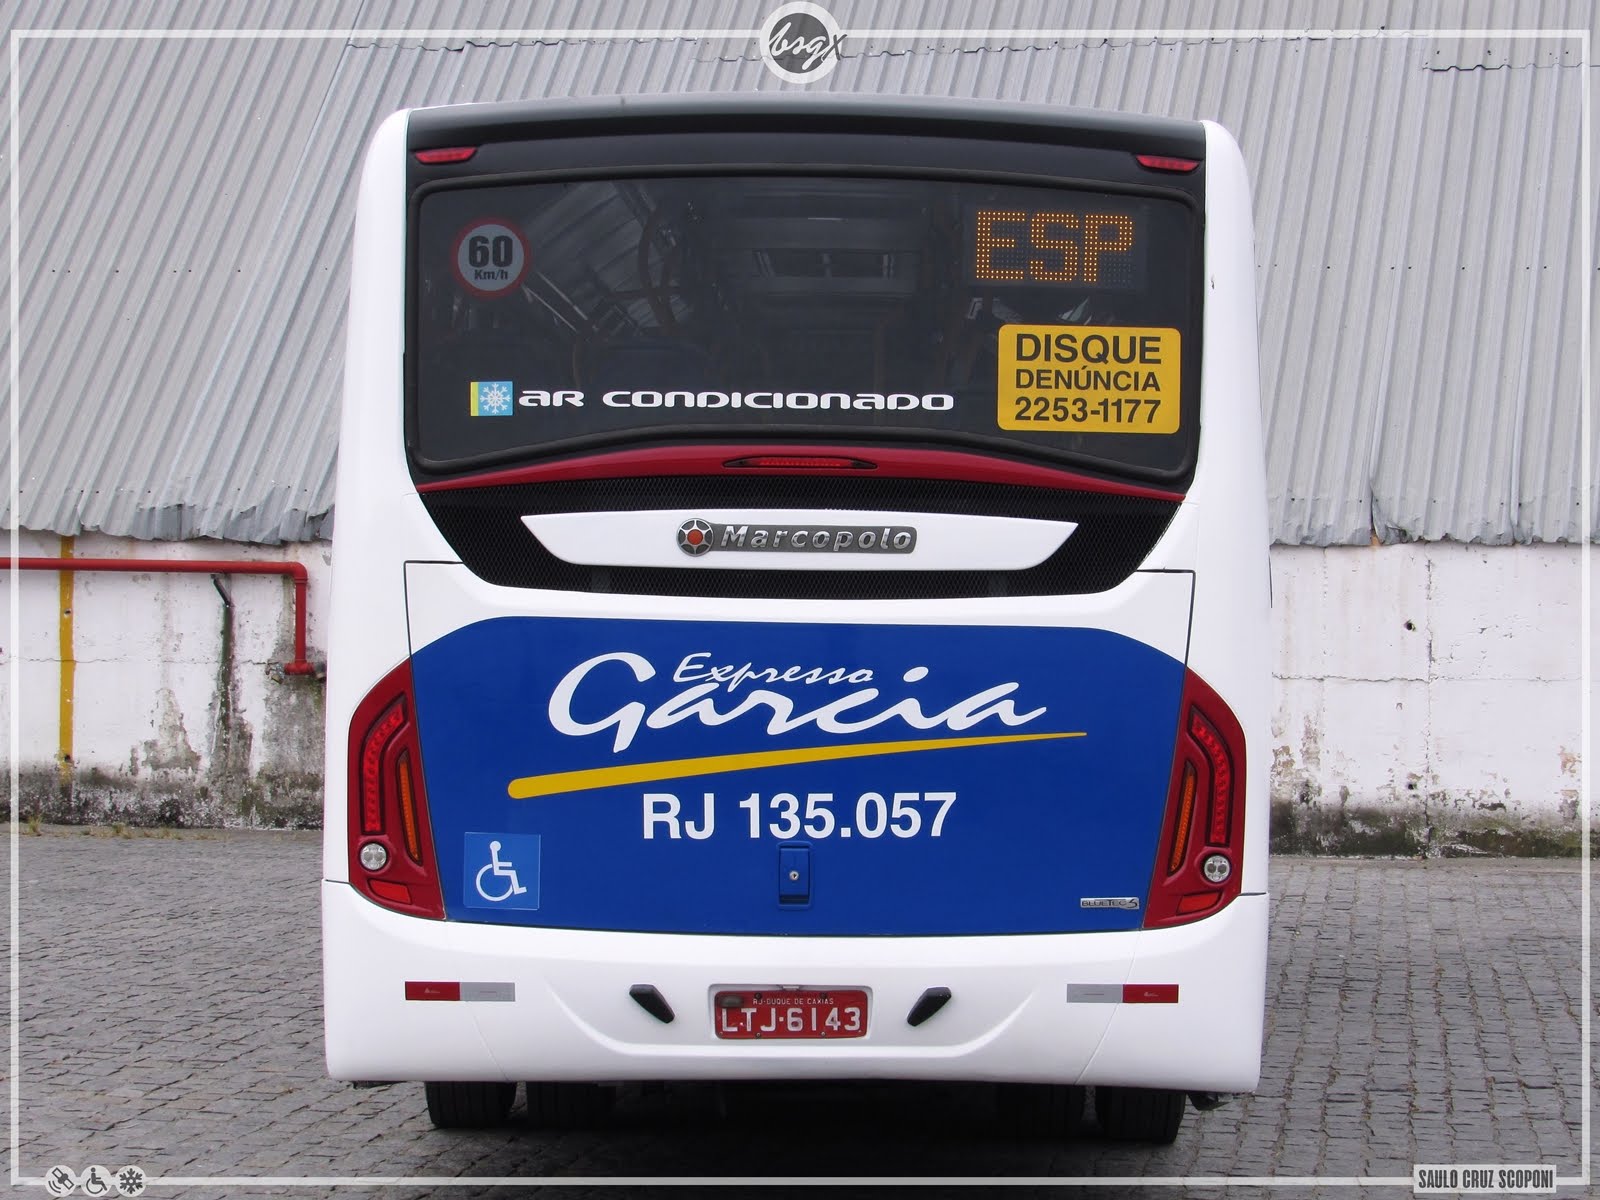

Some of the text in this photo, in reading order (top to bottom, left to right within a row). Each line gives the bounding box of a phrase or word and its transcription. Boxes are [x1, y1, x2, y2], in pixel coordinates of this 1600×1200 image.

[468, 235, 513, 268] 60
[976, 210, 1133, 282] ESP
[474, 269, 508, 281] Km/h
[1015, 333, 1162, 365] DISQUE
[1014, 365, 1161, 392] DENÚNCIA
[1014, 396, 1162, 424] 2253-1177
[720, 525, 912, 552] Marcopolo
[672, 652, 874, 692] Expresso
[548, 651, 1047, 754] Garcia
[643, 791, 957, 840] RJ 135.057
[794, 997, 803, 1006] DE
[807, 997, 834, 1006] CAXIAS
